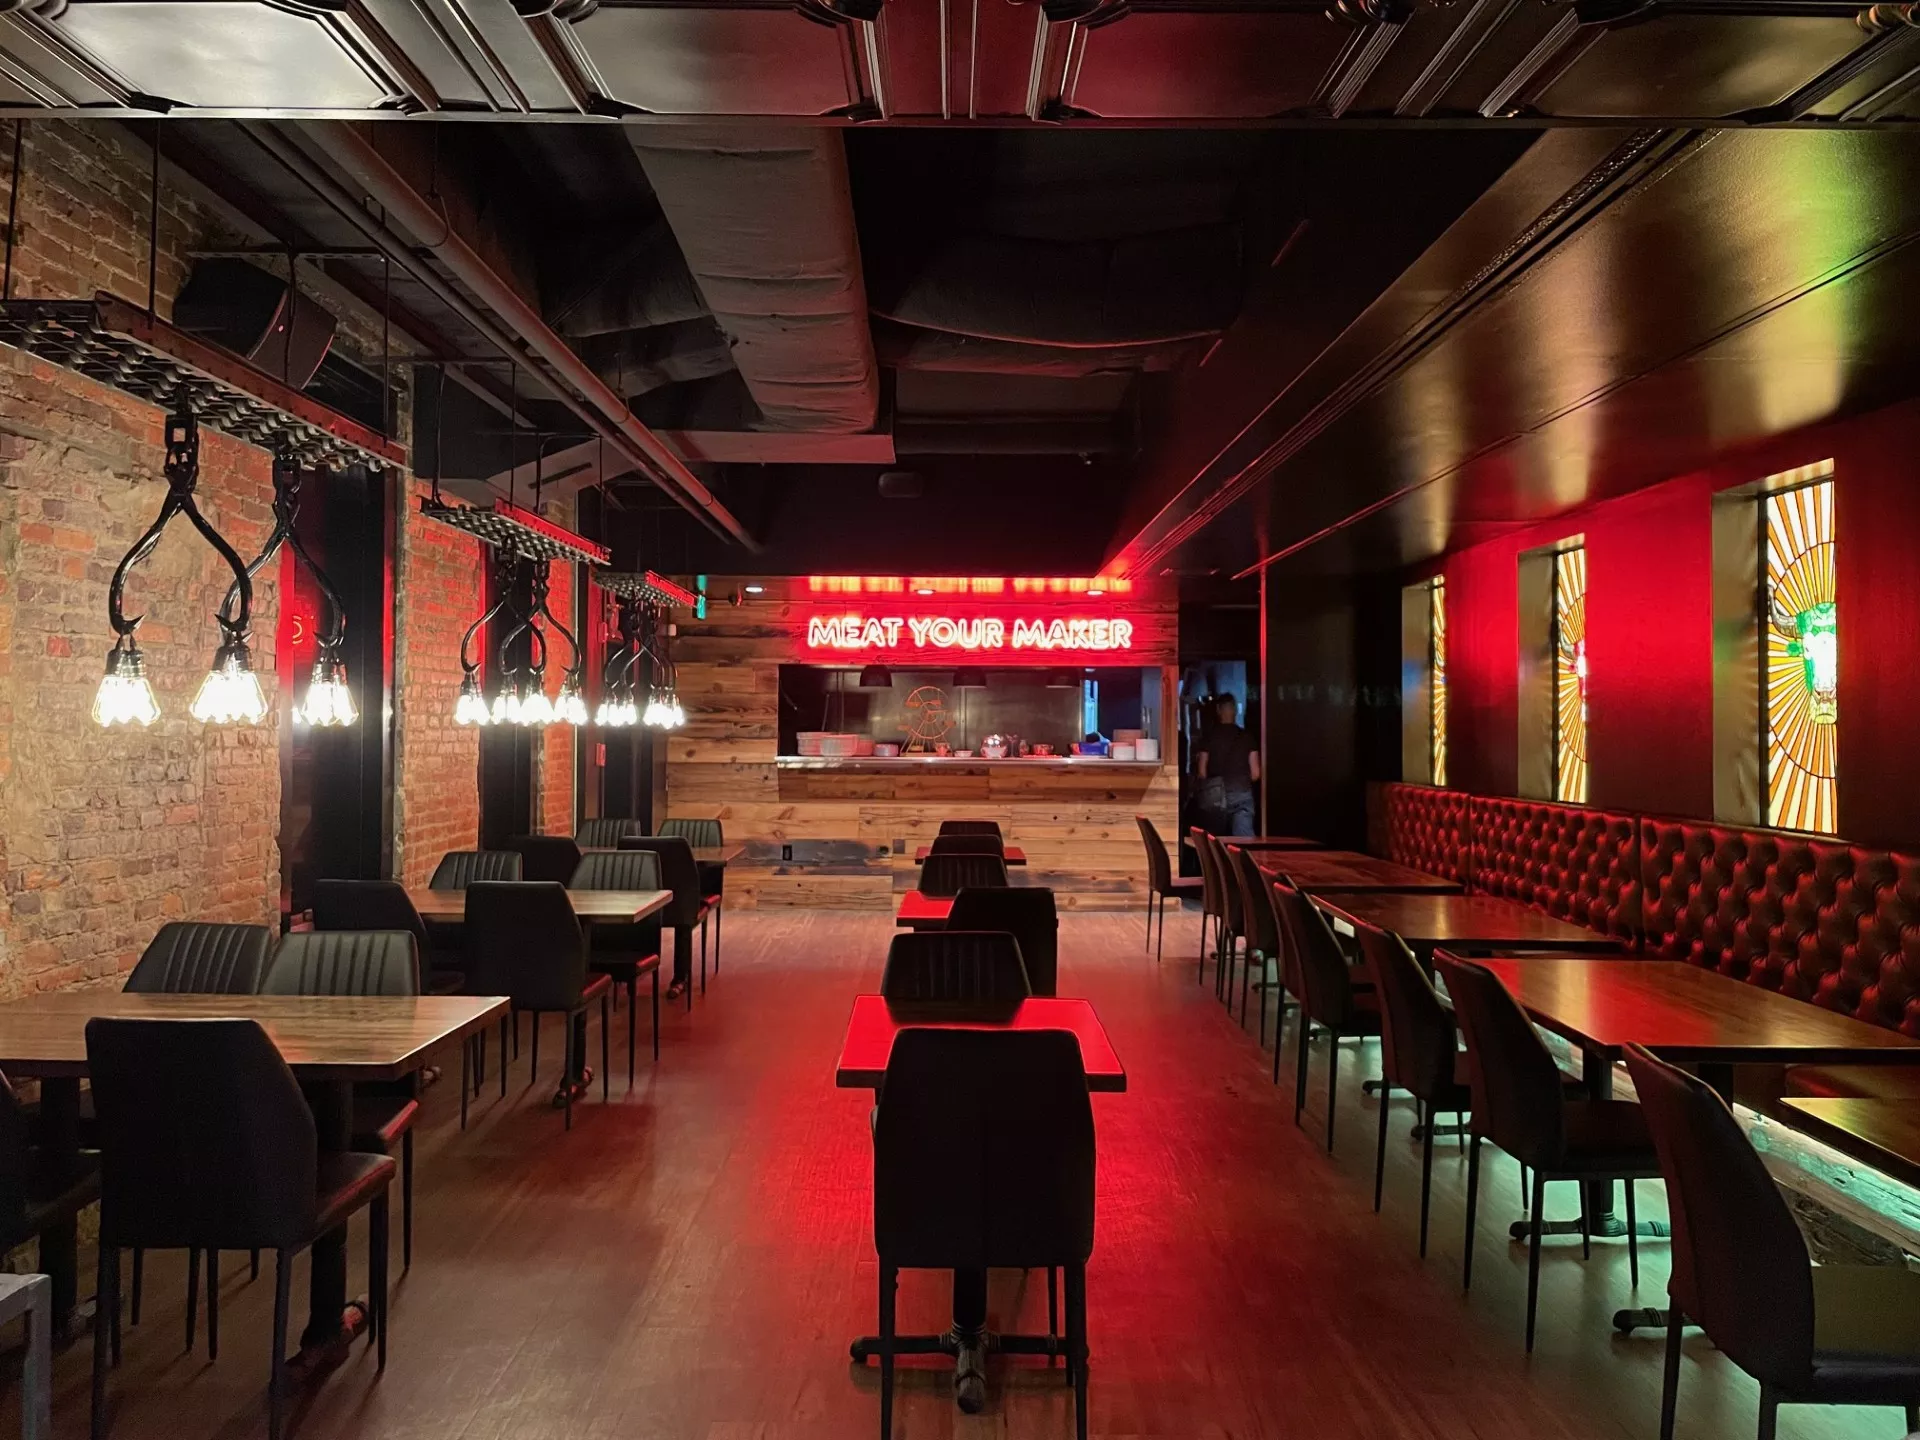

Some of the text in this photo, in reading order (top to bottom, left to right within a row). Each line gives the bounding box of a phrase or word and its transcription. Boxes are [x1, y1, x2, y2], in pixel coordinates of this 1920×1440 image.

[807, 616, 1133, 650] MEAT YOUR MAKER
